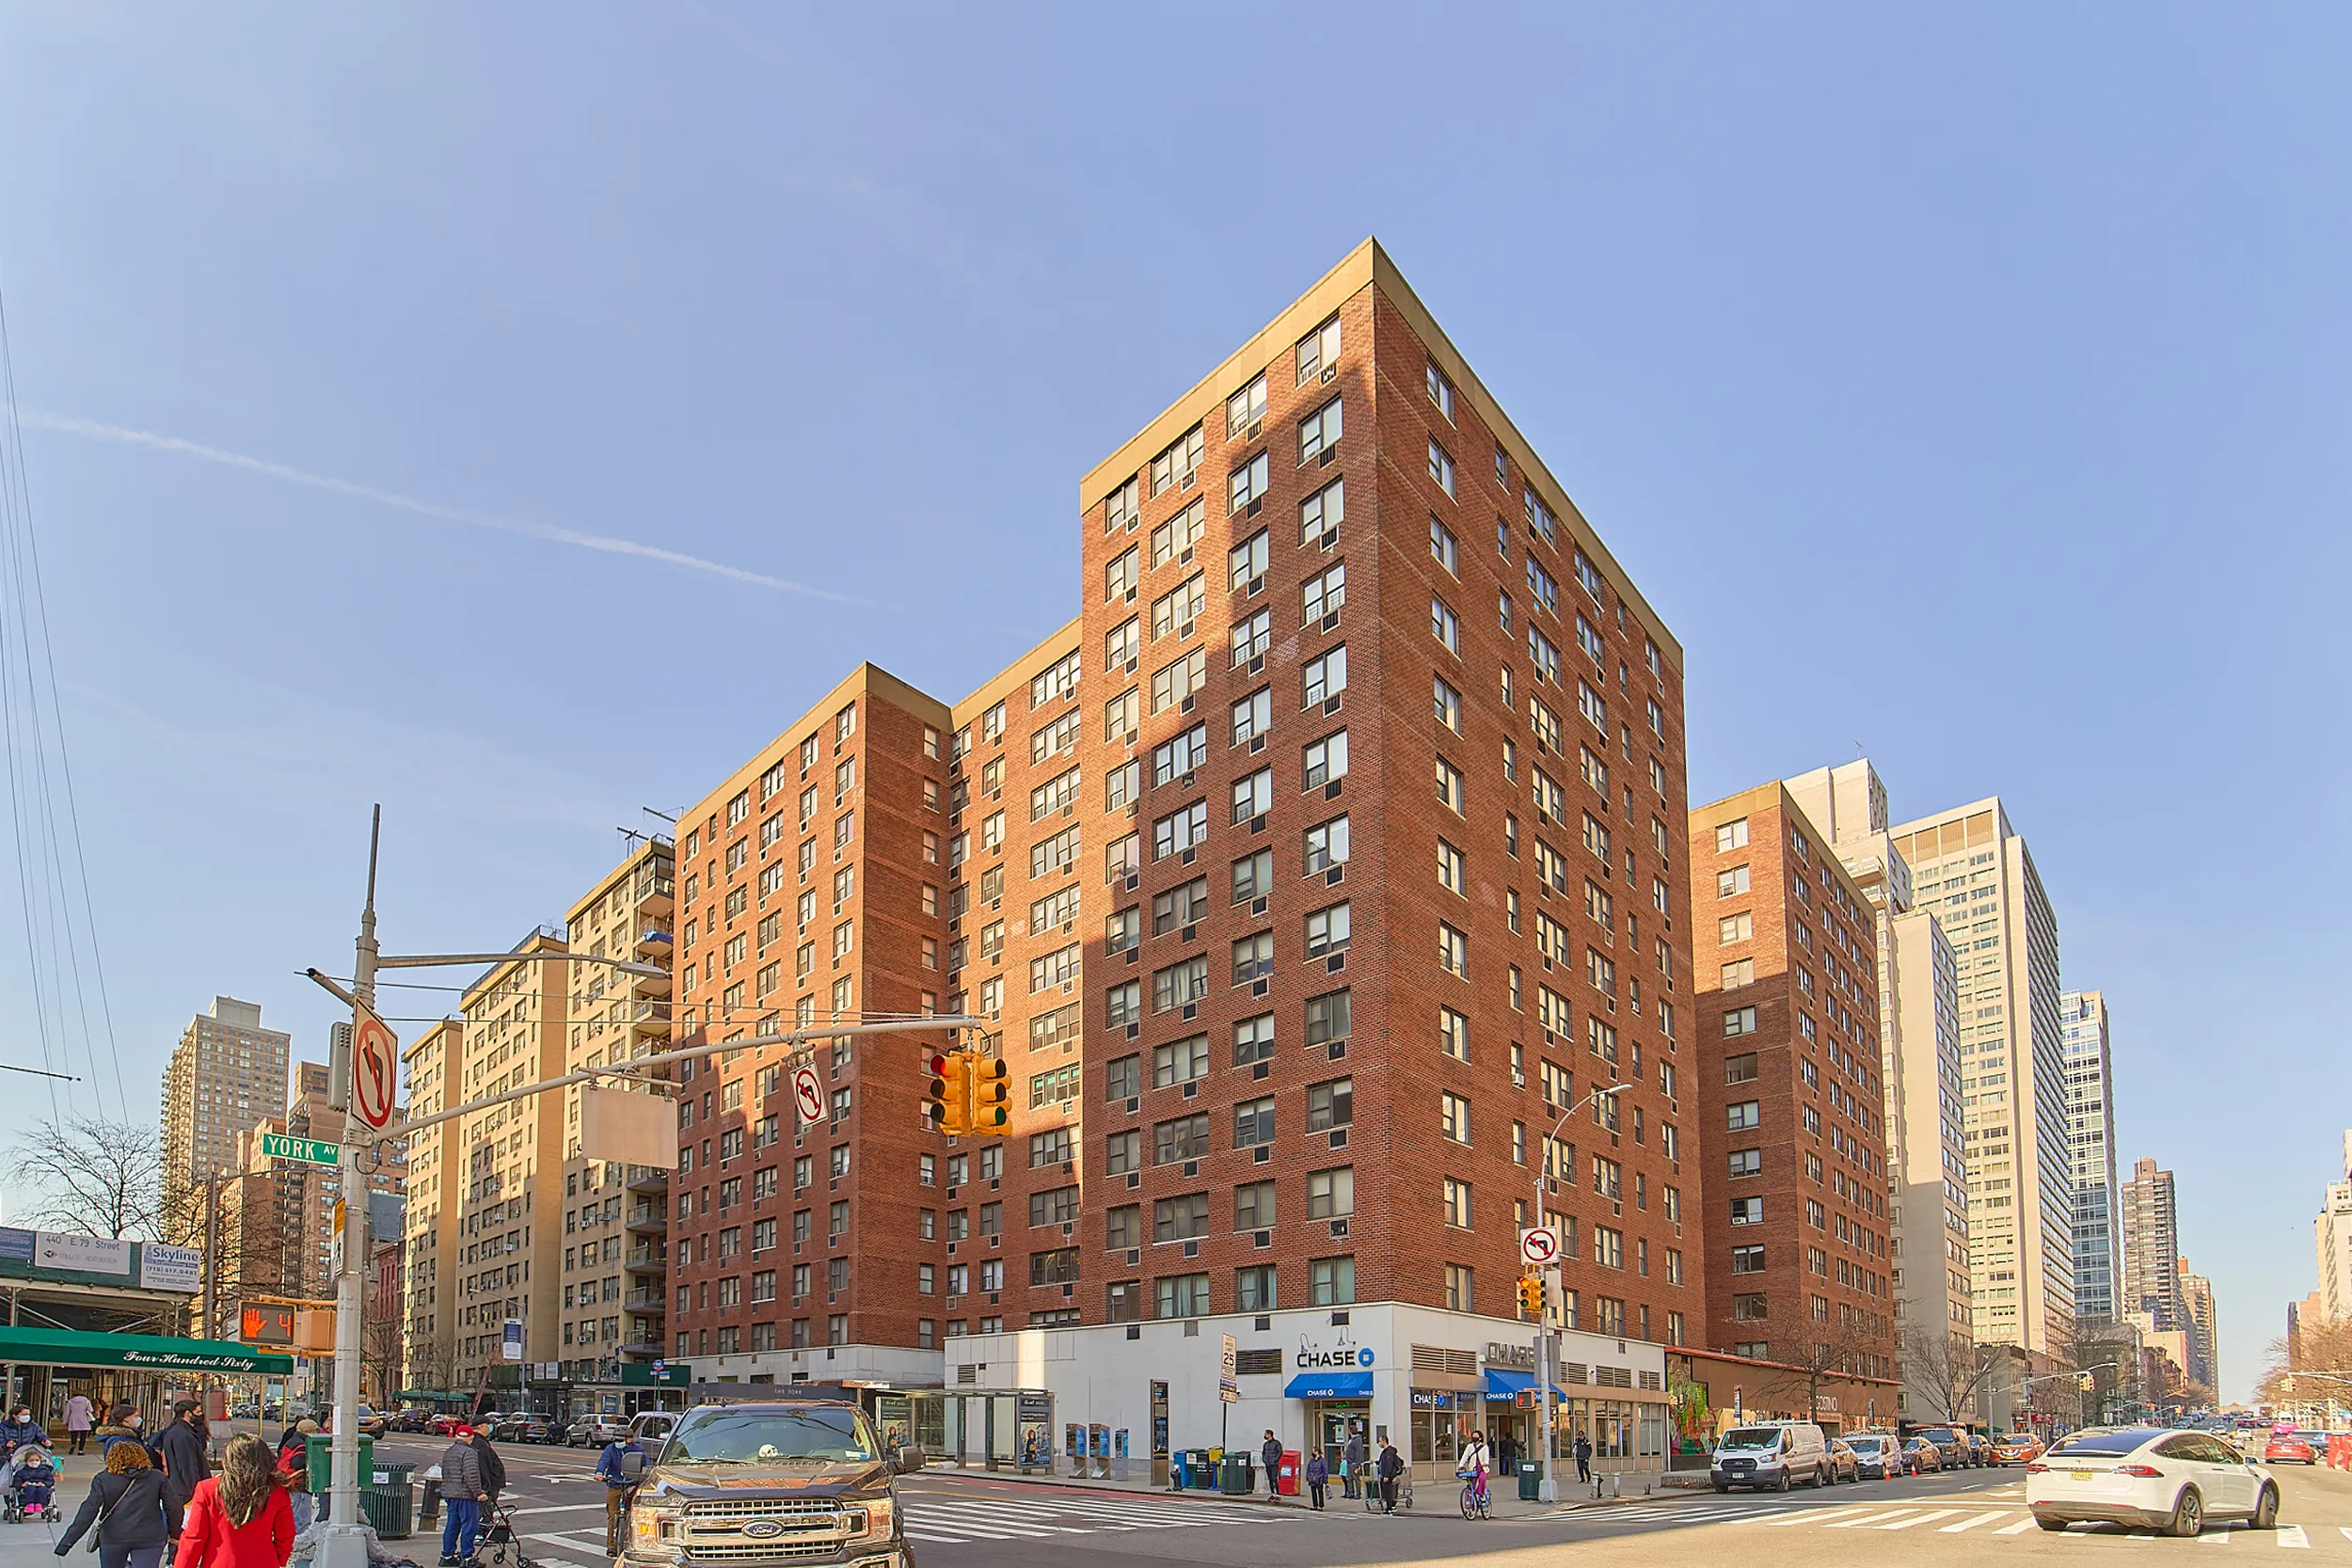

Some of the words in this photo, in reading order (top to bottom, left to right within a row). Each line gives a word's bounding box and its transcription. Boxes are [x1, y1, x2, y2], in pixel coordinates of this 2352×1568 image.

[267, 1135, 316, 1161] YORK
[323, 1143, 337, 1157] AV
[45, 1234, 62, 1244] 440
[79, 1238, 89, 1247] 79
[95, 1241, 120, 1251] Street
[152, 1247, 199, 1262] Skyline
[278, 1313, 292, 1338] 4
[123, 1351, 159, 1361] Four
[159, 1354, 220, 1367] Hundred
[1223, 1352, 1234, 1367] 25
[1296, 1351, 1356, 1368] CHASE
[1487, 1342, 1534, 1366] CHASE
[1414, 1394, 1438, 1404] CHASE
[754, 1526, 773, 1535] Ford
